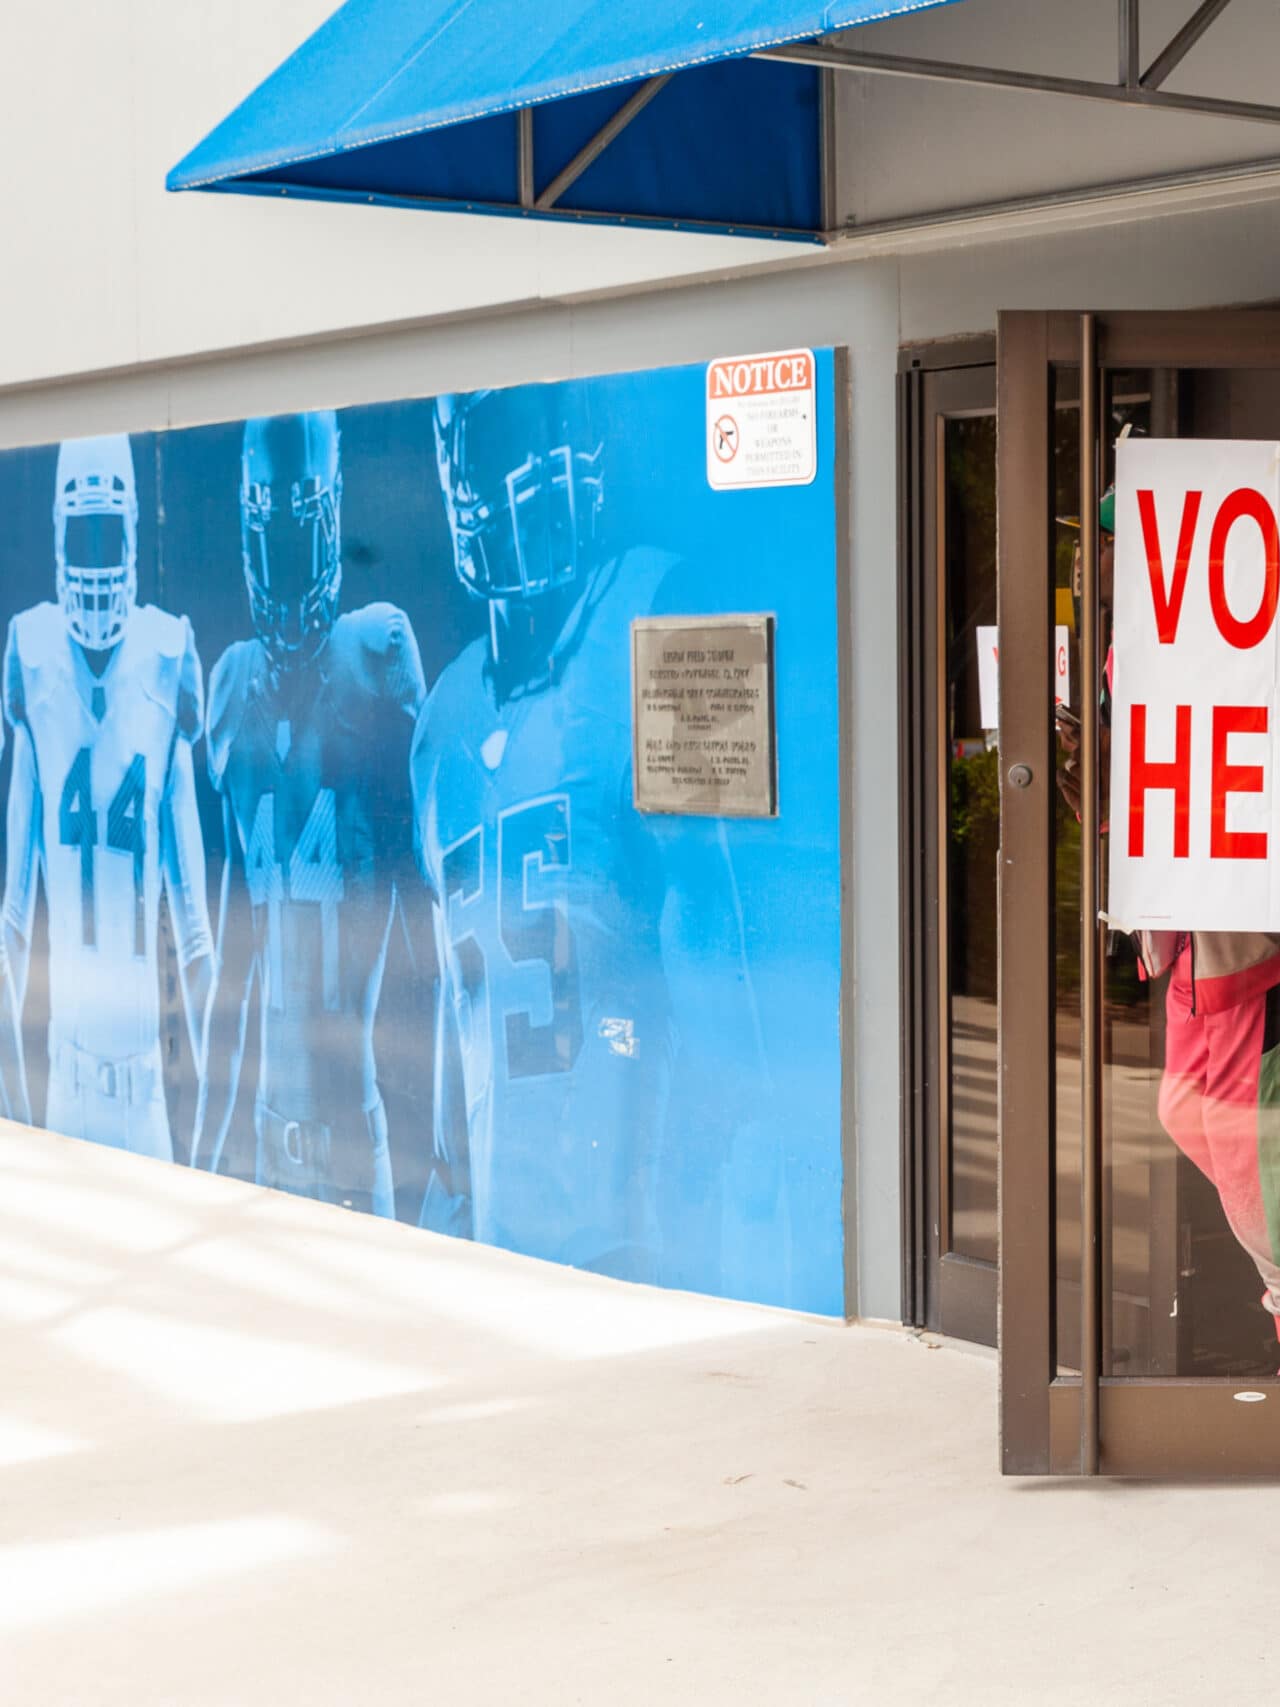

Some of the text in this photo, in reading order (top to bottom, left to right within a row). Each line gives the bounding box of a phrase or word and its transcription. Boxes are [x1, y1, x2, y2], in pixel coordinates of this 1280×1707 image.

[714, 358, 807, 396] NOTICE
[60, 747, 147, 957] 44
[248, 788, 344, 1010] 44
